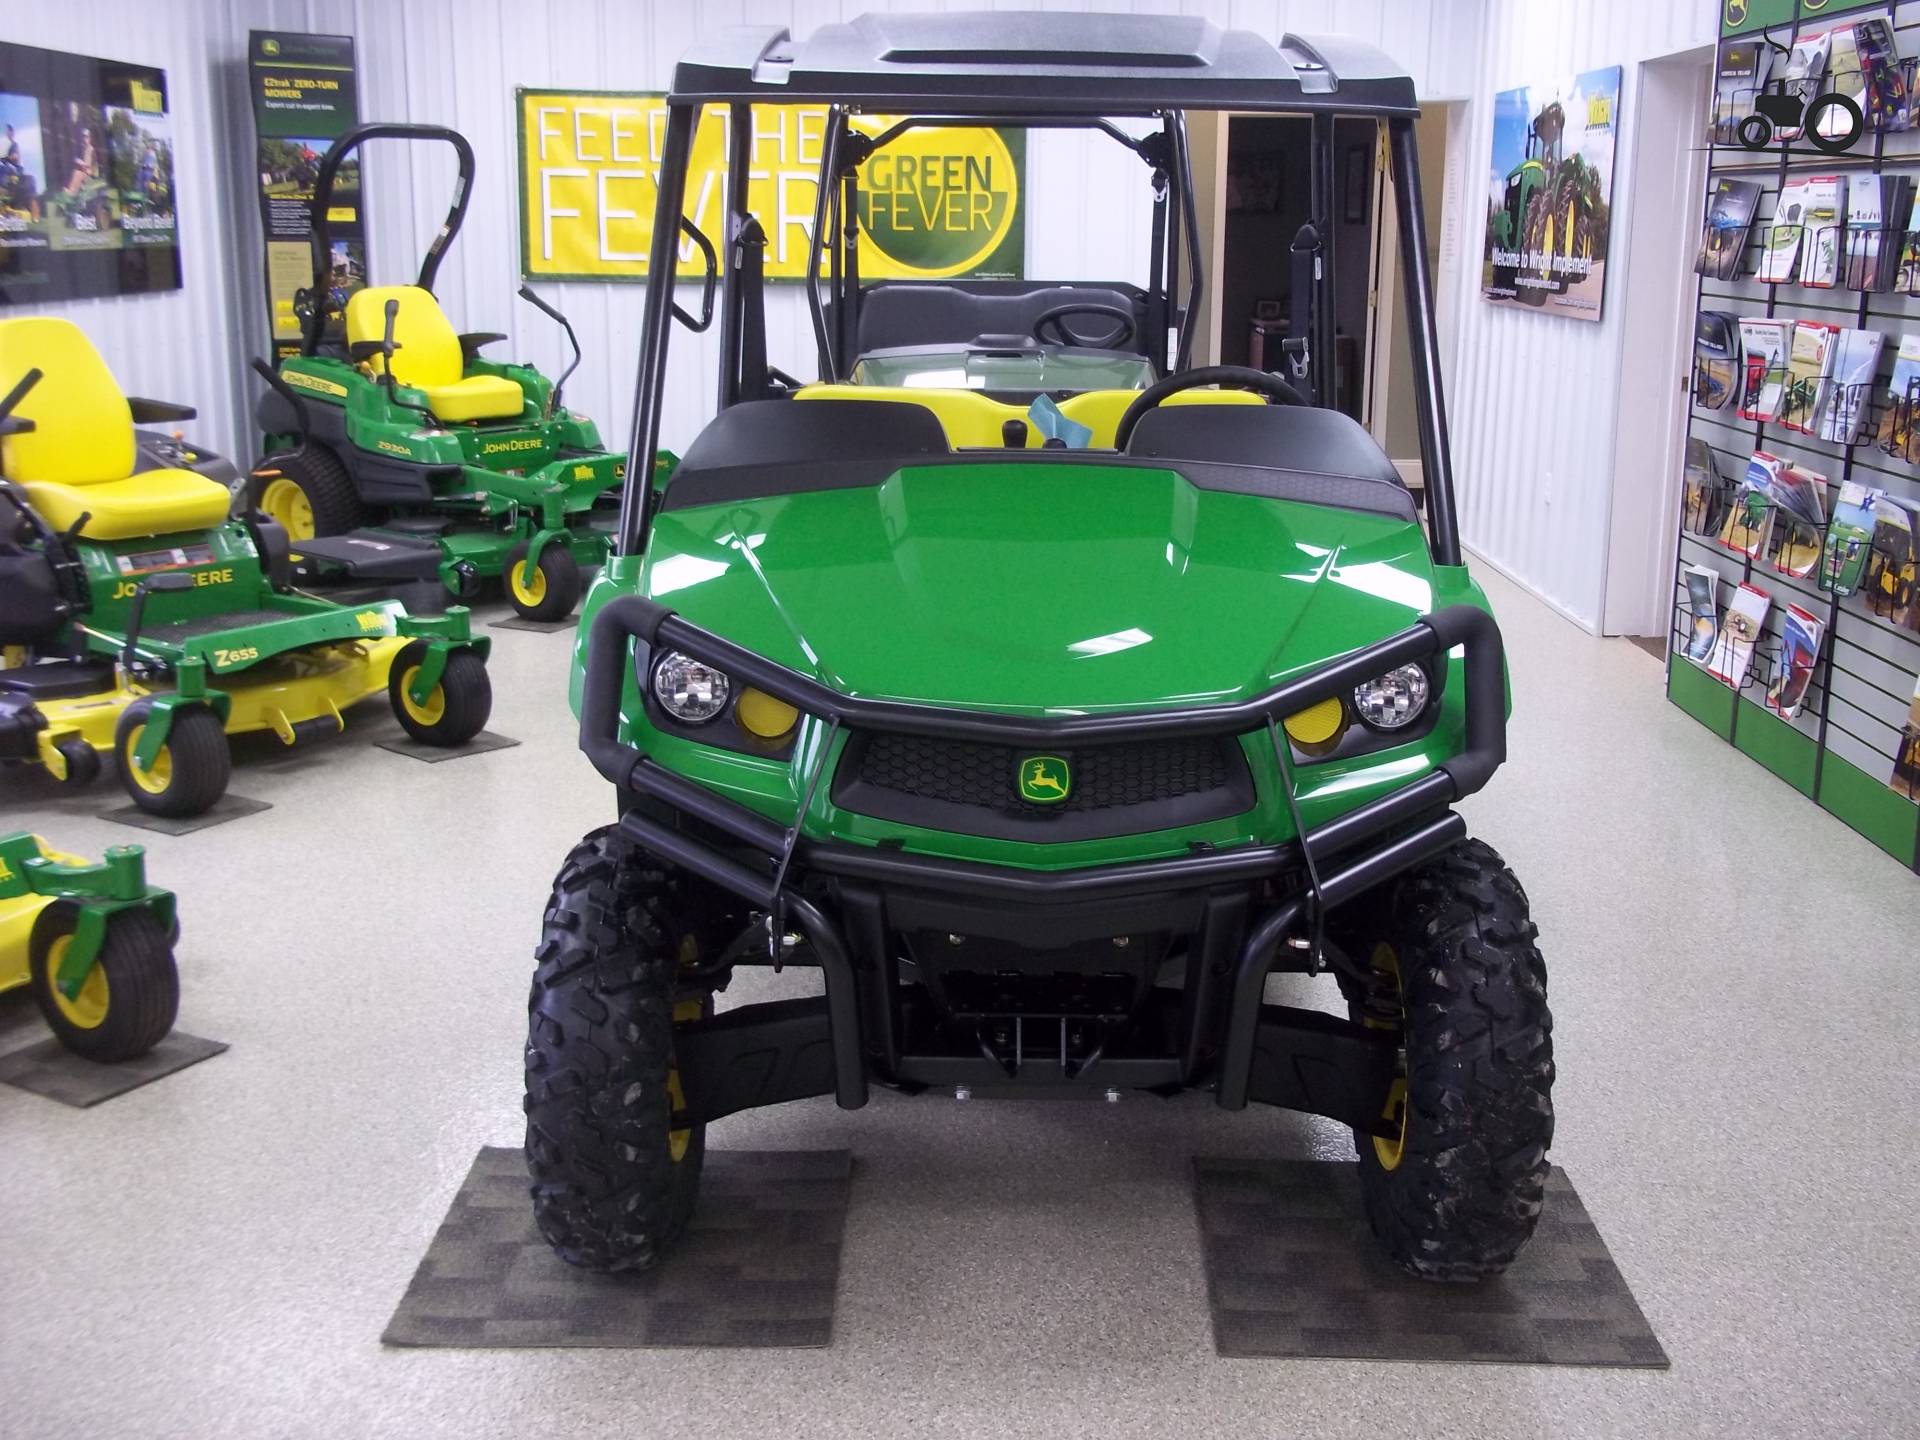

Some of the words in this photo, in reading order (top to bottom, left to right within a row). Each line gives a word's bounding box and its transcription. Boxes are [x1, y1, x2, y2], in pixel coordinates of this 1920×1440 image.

[264, 88, 303, 99] MOWERS
[710, 109, 828, 164] THE
[866, 154, 992, 192] GREEN
[541, 168, 829, 263] FEVER
[867, 187, 993, 231] FEVER
[1491, 246, 1521, 268] Welcome
[1520, 250, 1528, 268] to
[1529, 248, 1553, 276] Wright
[1552, 253, 1593, 278] Implement
[286, 373, 304, 386] JOHN
[303, 377, 332, 393] DEERE
[482, 443, 510, 455] JOHN
[510, 439, 543, 451] DEERE
[190, 569, 233, 588] ERE
[213, 647, 259, 667] Z655
